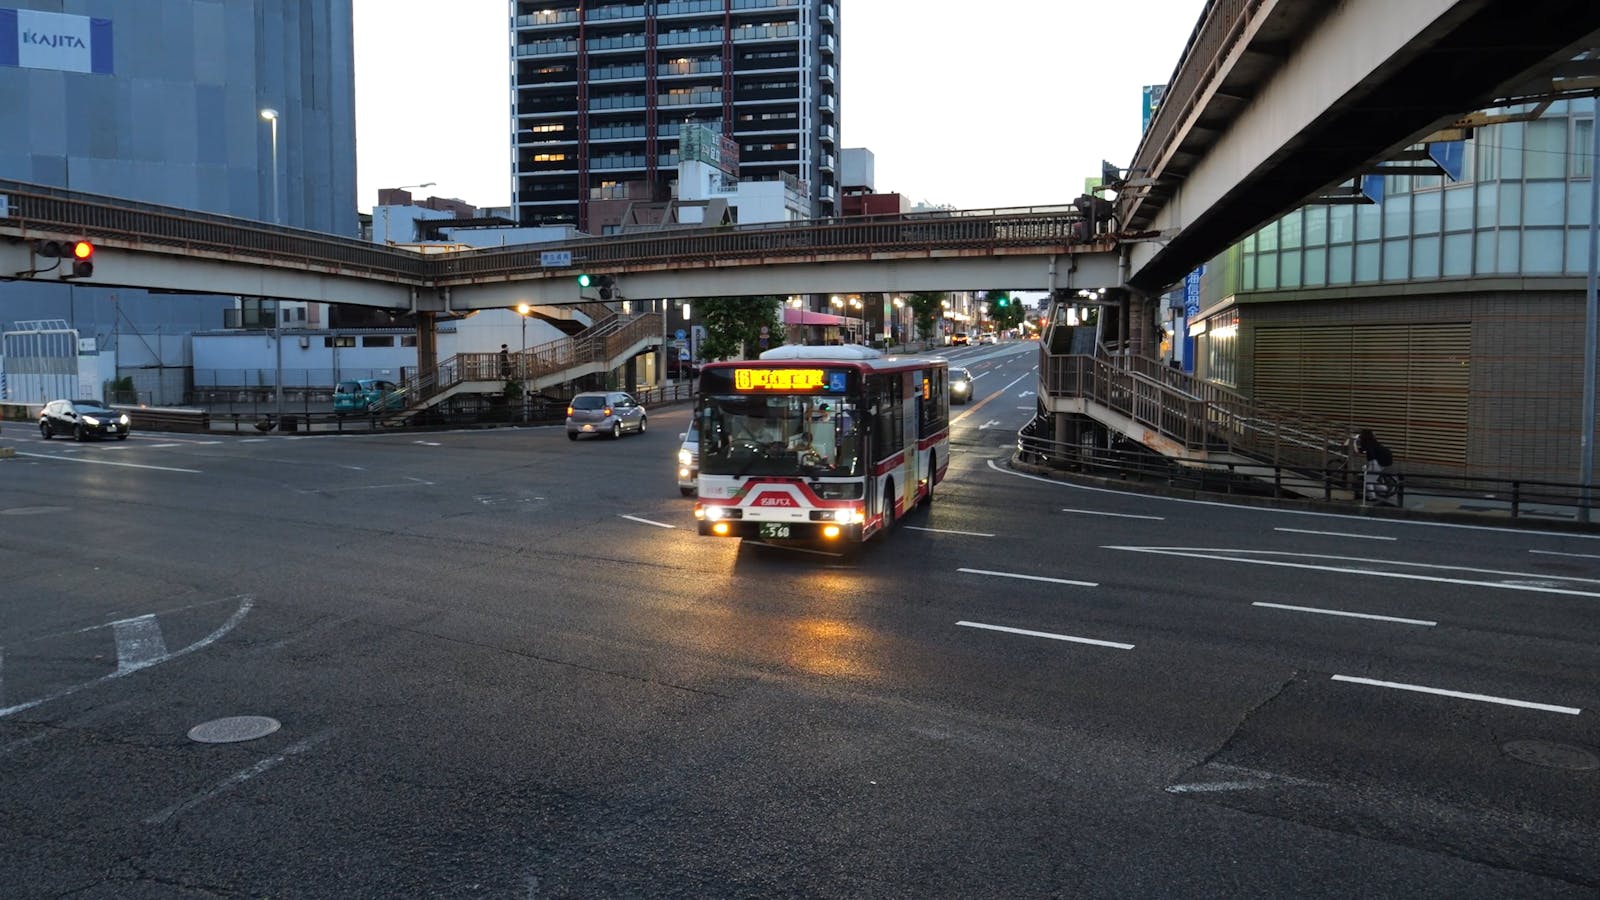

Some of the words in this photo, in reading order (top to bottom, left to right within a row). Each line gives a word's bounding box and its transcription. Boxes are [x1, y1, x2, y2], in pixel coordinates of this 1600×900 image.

[23, 29, 86, 49] KAJITA
[1186, 267, 1201, 318] 海信用金
